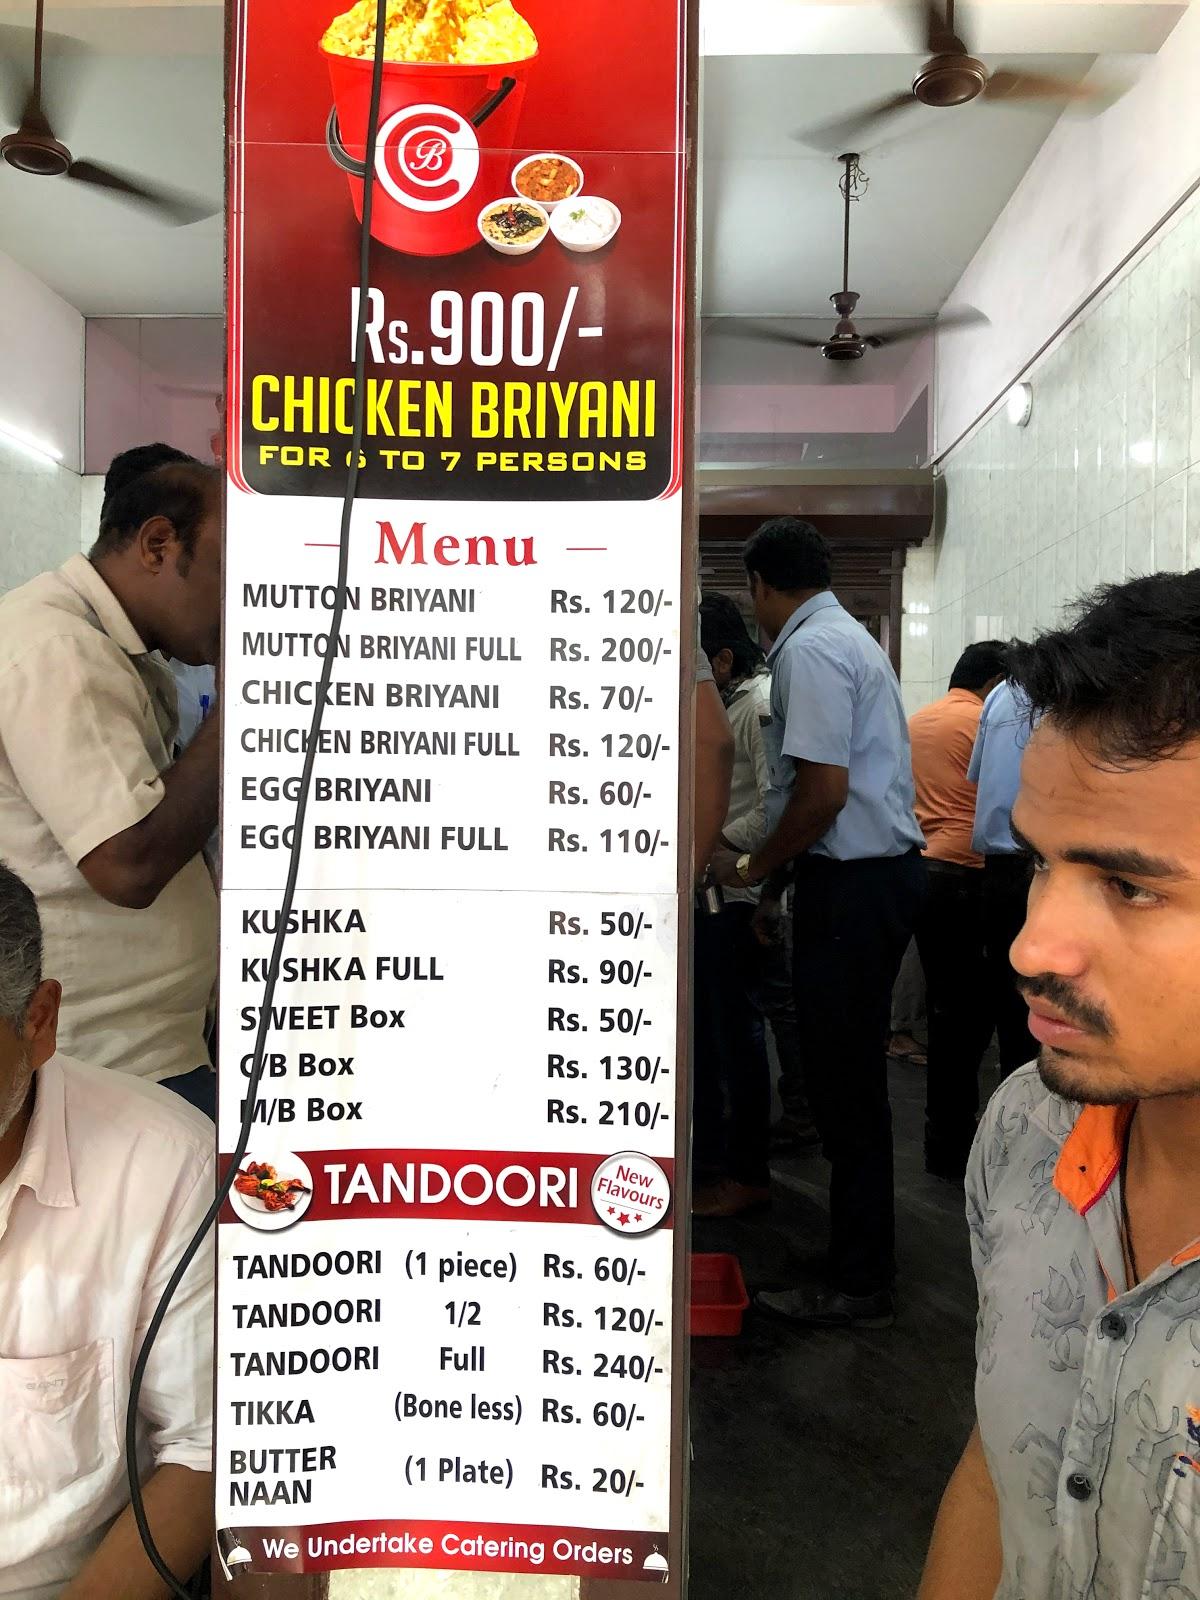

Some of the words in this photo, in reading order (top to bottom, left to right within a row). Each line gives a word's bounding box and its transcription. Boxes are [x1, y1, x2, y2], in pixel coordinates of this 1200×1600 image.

[350, 287, 603, 371] Rs.900/-
[252, 375, 453, 438] CHICKEN
[471, 380, 656, 439] BRIYANI
[260, 446, 331, 466] FOR
[380, 450, 425, 470] TO
[441, 452, 460, 471] 7
[477, 452, 647, 472] PERSONS
[375, 520, 538, 567] Menu
[243, 584, 360, 610] MUTTON
[372, 588, 474, 612] BRIYANI
[551, 590, 589, 613] Rs.
[603, 590, 672, 616] 120/-
[242, 632, 351, 659] MUTTON
[361, 635, 455, 660] BRIYANI
[466, 637, 521, 660] FULL
[551, 638, 589, 661] Rs.
[602, 638, 671, 664] 200/-
[242, 680, 375, 708] CHICKEN
[387, 684, 498, 708] BRIYANI
[550, 686, 588, 709] Rs.
[601, 686, 652, 712] 70/-
[241, 729, 351, 755] CHICKEN
[361, 731, 455, 755] BRIYANI
[465, 732, 519, 756] FULL
[550, 734, 588, 757] Rs.
[601, 734, 669, 760] 120/-
[241, 777, 302, 802] EGG
[315, 778, 432, 803] BRIYANI
[550, 781, 587, 804] Rs.
[600, 782, 651, 808] 60/-
[315, 826, 431, 850] BRIYANI
[442, 827, 508, 850] FULL
[549, 828, 587, 852] Rs.
[601, 829, 668, 856] 110/-
[242, 909, 366, 934] KUSHKA
[550, 911, 588, 935] Rs.
[601, 912, 652, 939] 50/-
[242, 957, 366, 983] KUSHKA
[377, 957, 443, 980] FULL
[549, 959, 587, 983] Rs.
[600, 960, 652, 987] 90/-
[241, 1005, 341, 1031] SWEET
[351, 1005, 405, 1028] Box
[548, 1008, 587, 1031] Rs.
[600, 1008, 651, 1035] 50/-
[240, 1053, 287, 1080] C/B
[299, 1053, 354, 1076] Box
[548, 1054, 587, 1078] Rs.
[600, 1056, 669, 1084] 130/-
[240, 1099, 295, 1126] M/B
[308, 1098, 362, 1121] Box
[548, 1099, 586, 1123] Rs.
[599, 1101, 669, 1129] 210/-
[324, 1164, 579, 1208] TANDOORI
[616, 1165, 654, 1188] New
[597, 1178, 664, 1210] Flavours
[233, 1251, 381, 1279] TANDOORI
[405, 1249, 428, 1279] (1
[440, 1251, 516, 1282] piece)
[544, 1254, 582, 1279] Rs.
[595, 1257, 645, 1285] 60/-
[233, 1299, 380, 1328] TANDOORI
[445, 1301, 480, 1327] 1/2
[544, 1303, 581, 1328] Rs.
[595, 1307, 663, 1335] 120/-
[231, 1346, 378, 1376] TANDOORI
[441, 1346, 484, 1371] Full
[543, 1350, 581, 1375] Rs.
[594, 1354, 662, 1382] 240/-
[231, 1400, 315, 1425] TIKKA
[395, 1392, 462, 1421] (Bone
[472, 1394, 521, 1425] less)
[543, 1399, 581, 1423] Rs.
[594, 1402, 644, 1430] 60/-
[231, 1446, 336, 1474] BUTTER
[230, 1479, 311, 1506] NAAN
[406, 1456, 425, 1485] (1
[440, 1457, 512, 1489] Plate)
[542, 1464, 580, 1490] Rs.
[593, 1468, 644, 1497] 20/-
[262, 1538, 300, 1560] We
[308, 1533, 433, 1558] Undertake
[441, 1534, 546, 1564] Catering
[553, 1539, 633, 1565] Orders
